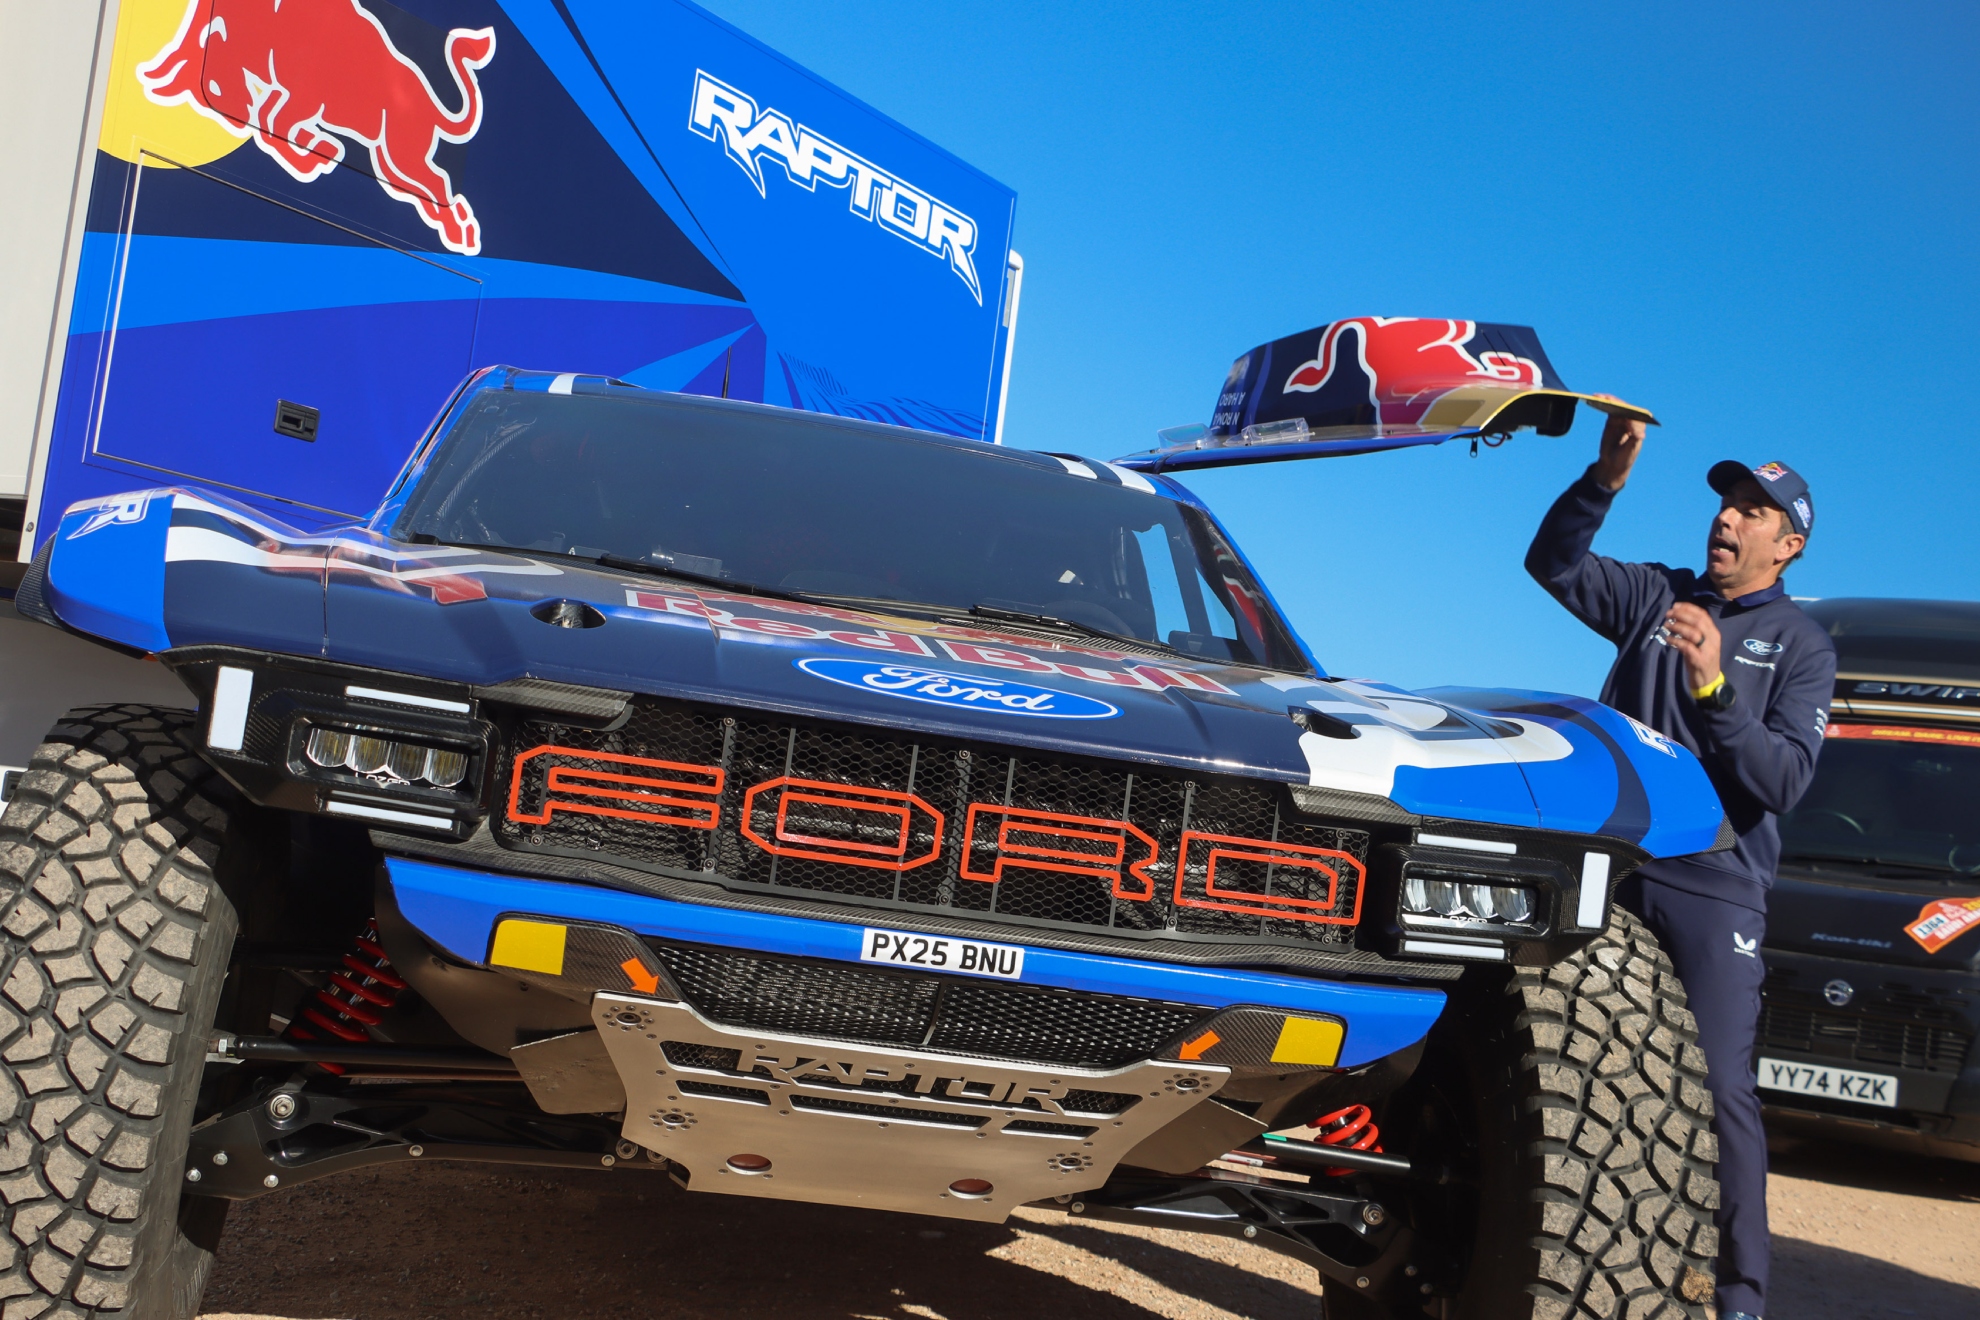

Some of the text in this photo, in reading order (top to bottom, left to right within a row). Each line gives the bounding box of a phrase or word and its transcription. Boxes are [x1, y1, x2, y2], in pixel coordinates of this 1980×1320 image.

[689, 68, 983, 307] RAPTOR
[625, 589, 1242, 697] Red Bull
[862, 666, 1056, 712] Ford
[506, 744, 1367, 927] FORD
[870, 932, 1018, 975] PX25 BNU
[736, 1049, 1070, 1115] RAPTOR
[1770, 1063, 1888, 1102] YY74 KZK
